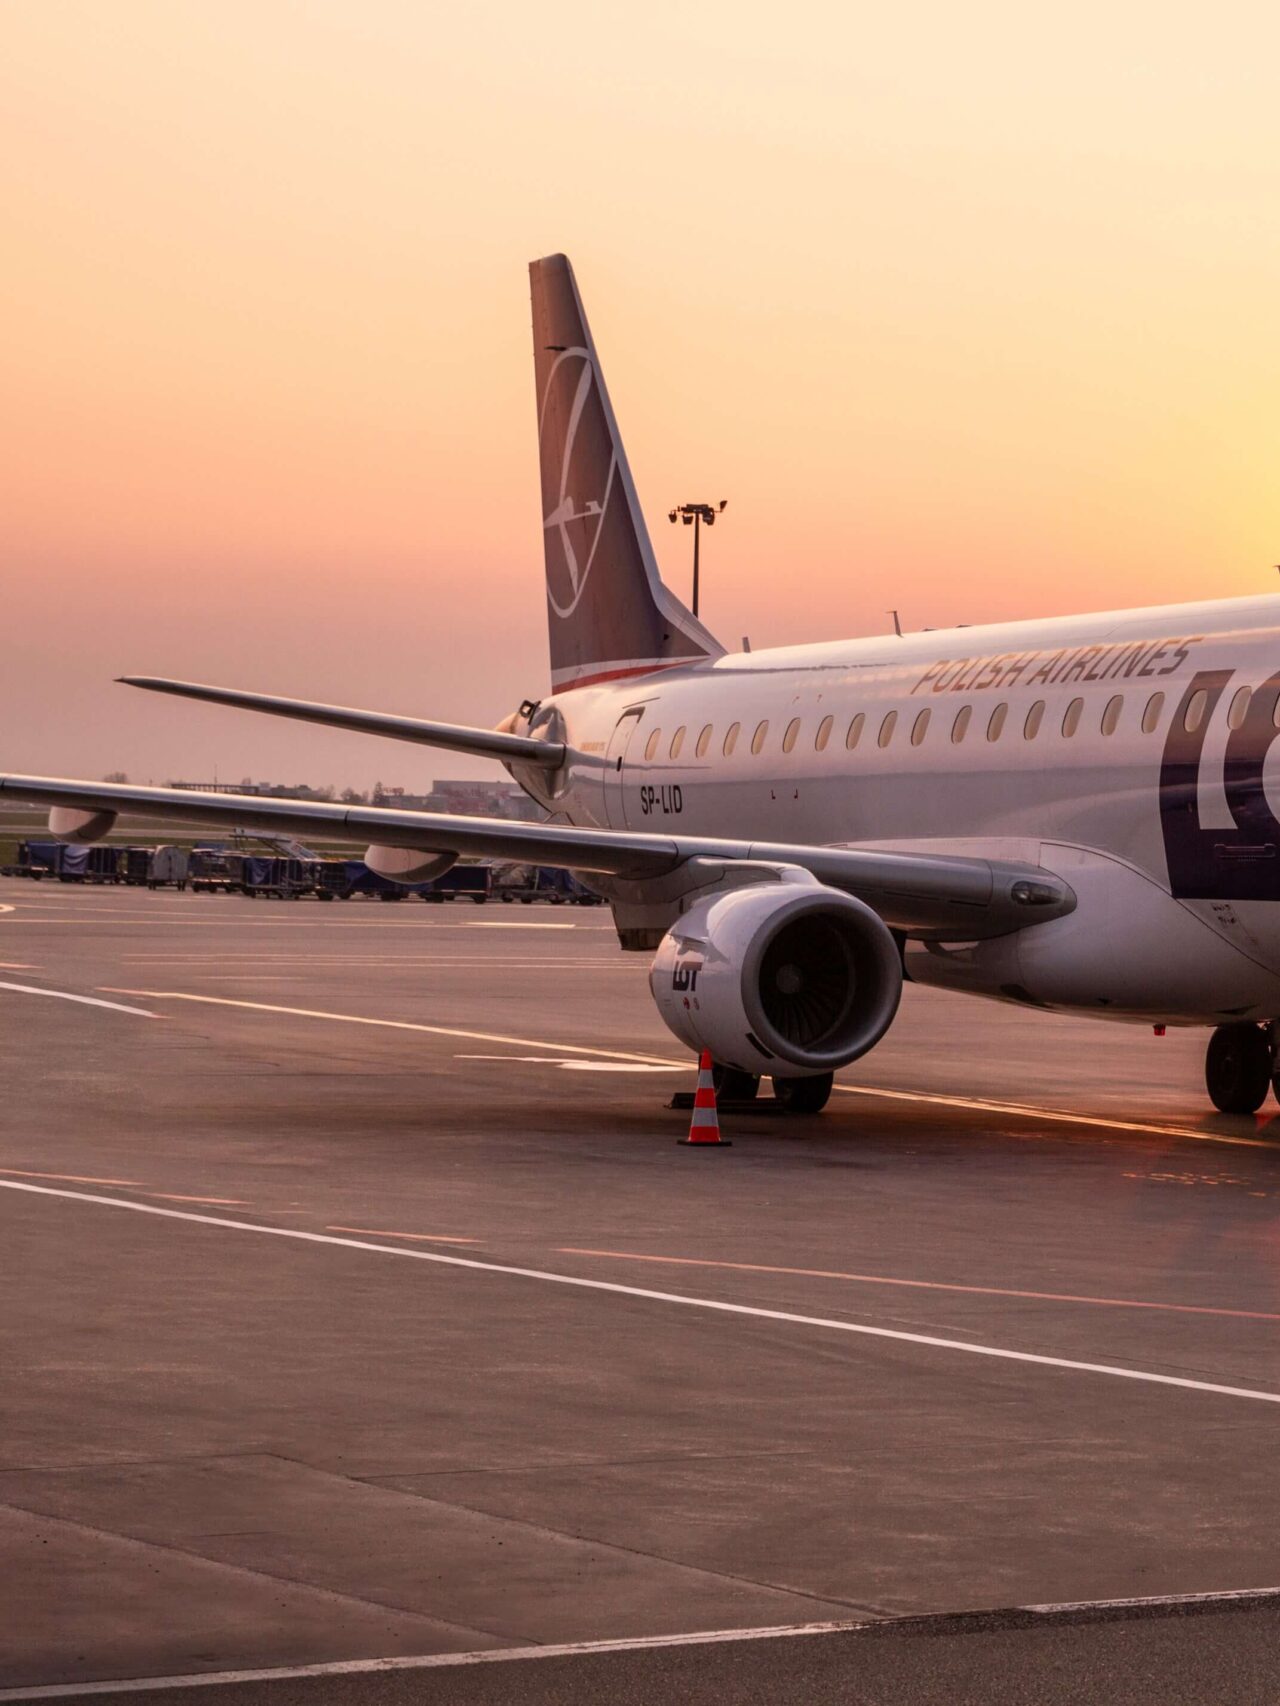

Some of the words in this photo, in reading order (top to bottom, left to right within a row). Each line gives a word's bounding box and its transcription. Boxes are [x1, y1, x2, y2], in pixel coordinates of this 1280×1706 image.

[910, 651, 1042, 695] POLISH
[1026, 636, 1205, 687] AIRLINES
[640, 784, 683, 815] SP-LID
[672, 961, 703, 992] LOT
